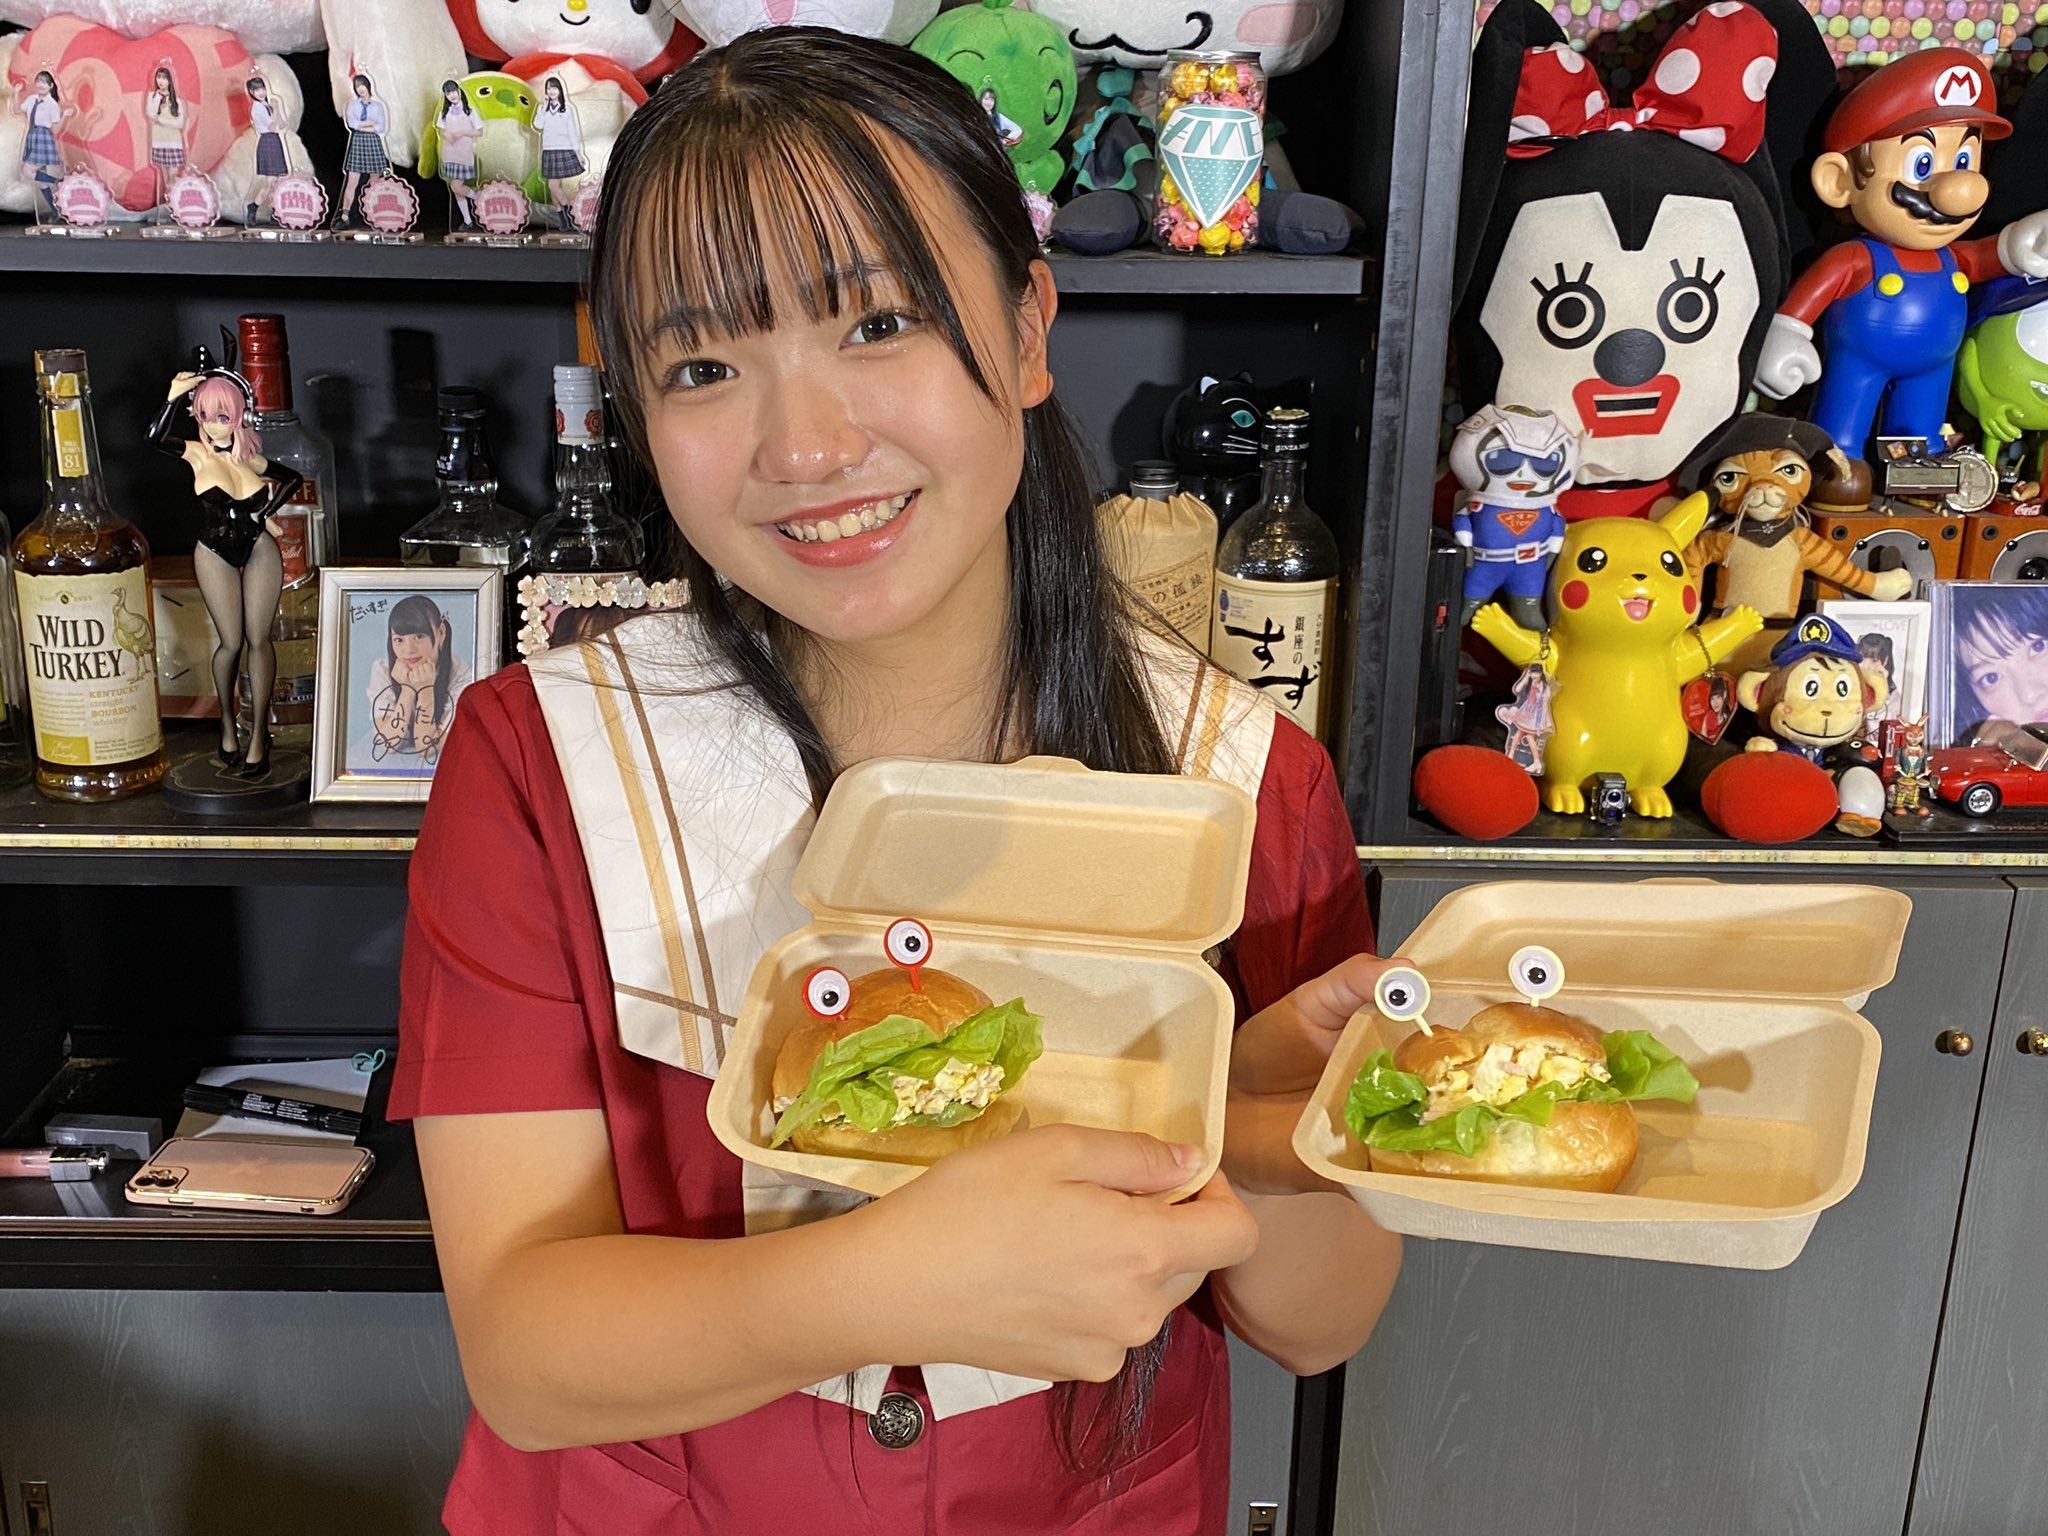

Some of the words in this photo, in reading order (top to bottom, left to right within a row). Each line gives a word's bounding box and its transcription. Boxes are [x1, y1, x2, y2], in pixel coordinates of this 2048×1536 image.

[1940, 71, 1977, 100] M
[64, 453, 81, 469] 81
[36, 614, 105, 648] WILD
[29, 642, 123, 683] TURKEY
[89, 685, 140, 699] KENTUCKY
[91, 704, 138, 718] BOURBON
